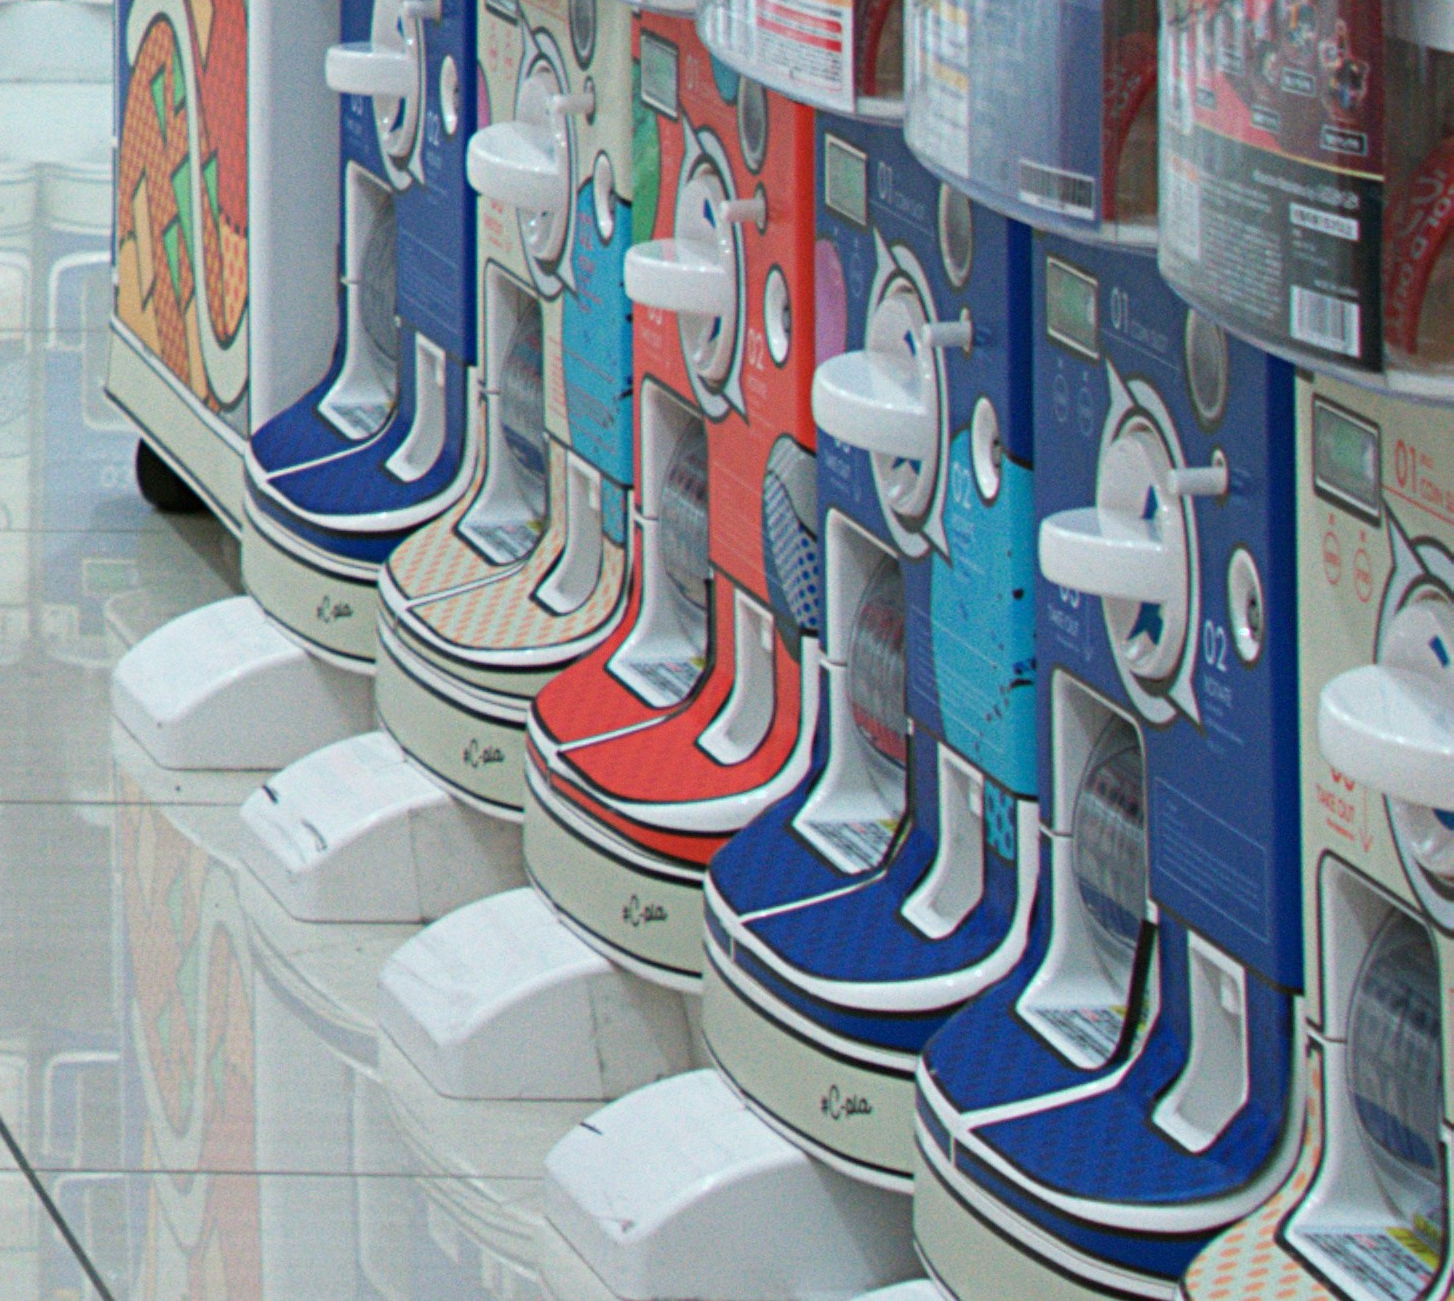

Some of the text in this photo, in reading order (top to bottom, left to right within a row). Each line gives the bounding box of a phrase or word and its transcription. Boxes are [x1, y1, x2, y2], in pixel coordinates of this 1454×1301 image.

[1110, 289, 1129, 330] 01
[1395, 439, 1418, 489] 01
[1203, 624, 1227, 673] 02
